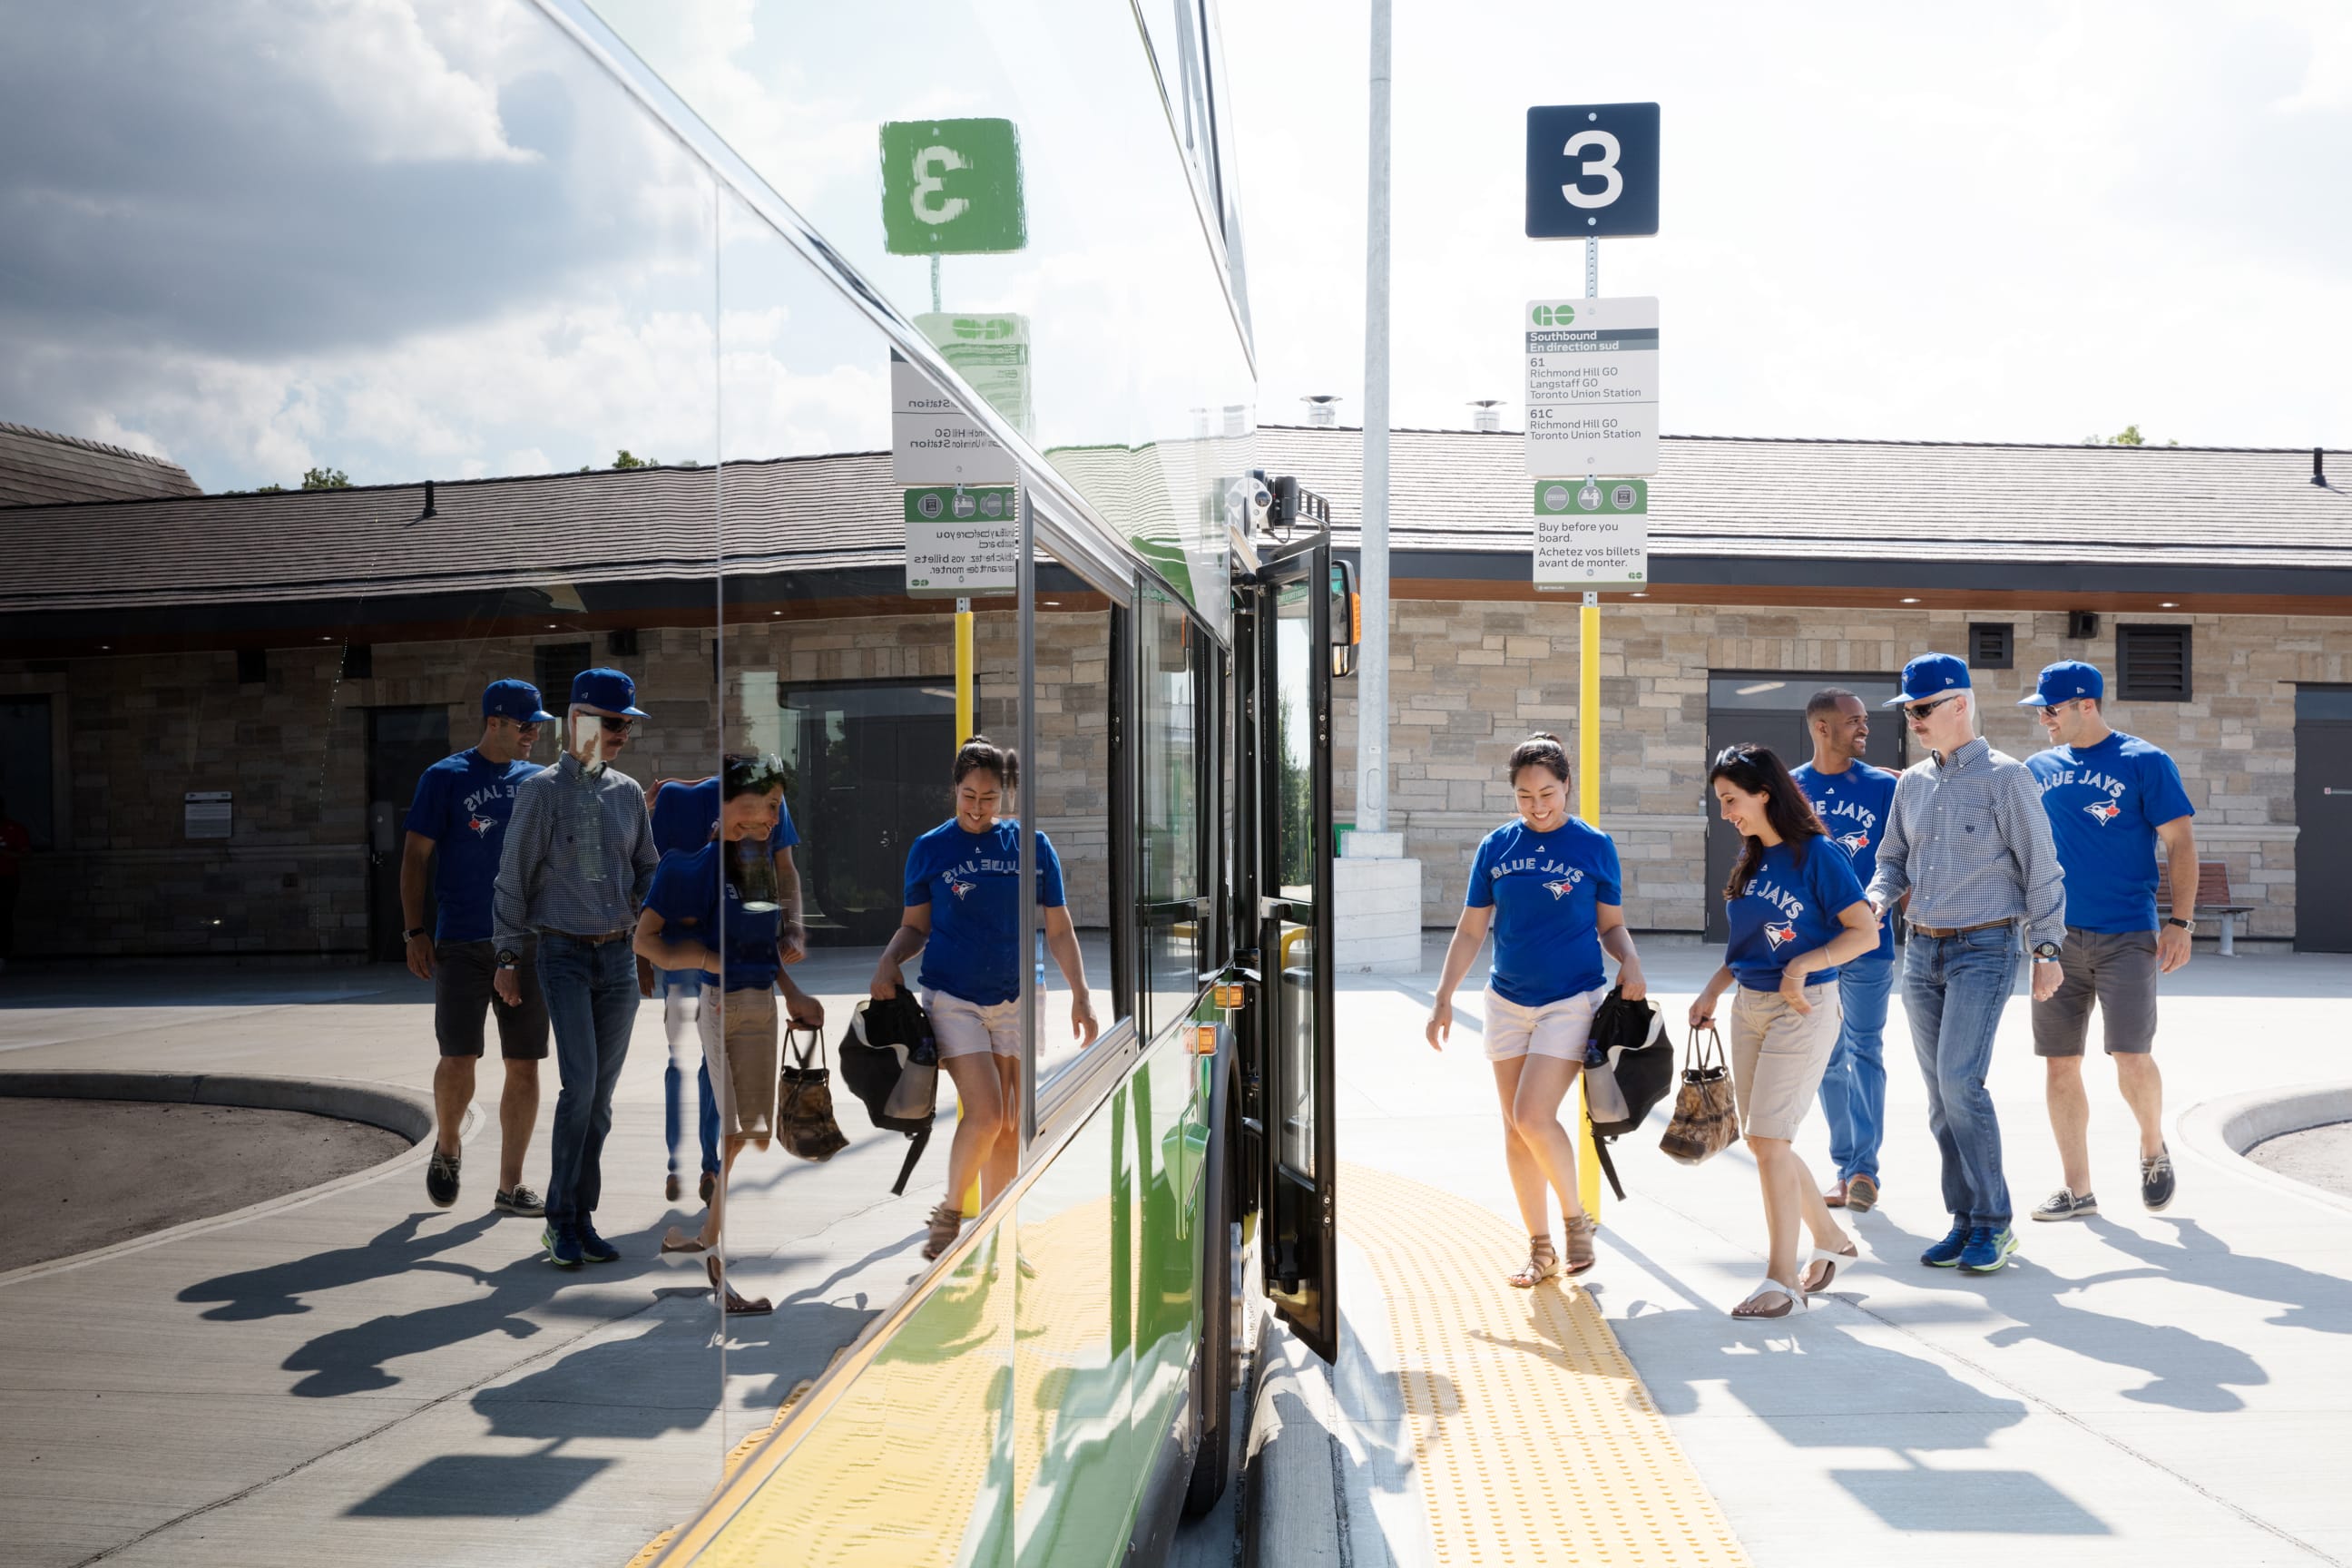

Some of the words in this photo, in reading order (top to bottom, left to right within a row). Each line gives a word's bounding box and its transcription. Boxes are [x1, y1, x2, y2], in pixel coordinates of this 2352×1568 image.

[1562, 130, 1623, 209] 3
[1532, 304, 1575, 326] GO
[1530, 330, 1597, 342] Southbound
[1530, 343, 1544, 352] En
[1546, 341, 1597, 352] direction
[1599, 341, 1619, 350] sud
[1530, 358, 1545, 368] 61
[1530, 368, 1581, 378] Richmond
[1583, 368, 1600, 377] Hill
[1602, 367, 1618, 376] GO
[1530, 378, 1580, 390] Langstaff
[1583, 377, 1598, 387] GO
[1531, 390, 1569, 399] Toronto
[1572, 389, 1601, 398] Union
[1603, 388, 1642, 397] Station
[1530, 408, 1553, 418] 61C
[1530, 419, 1581, 429] Richmond
[1583, 419, 1600, 428] Hill
[1602, 418, 1618, 427] GO
[1531, 431, 1569, 440] Toronto
[1572, 430, 1601, 439] Union
[1603, 429, 1642, 438] Station
[1539, 523, 1559, 534] Buy
[1562, 522, 1597, 532] before
[1599, 523, 1619, 533] you
[1539, 534, 1573, 543] board.
[1539, 547, 1583, 556] Achetez
[1606, 547, 1641, 555] billets
[1539, 559, 1569, 567] avant
[1571, 558, 1584, 567] de
[1587, 558, 1628, 567] monter.
[2078, 769, 2126, 798] JAYS
[1831, 800, 1876, 828] JAYS
[1490, 858, 1536, 879] BLUE
[1541, 859, 1584, 884] JAYS
[1757, 880, 1804, 919] JAYS
